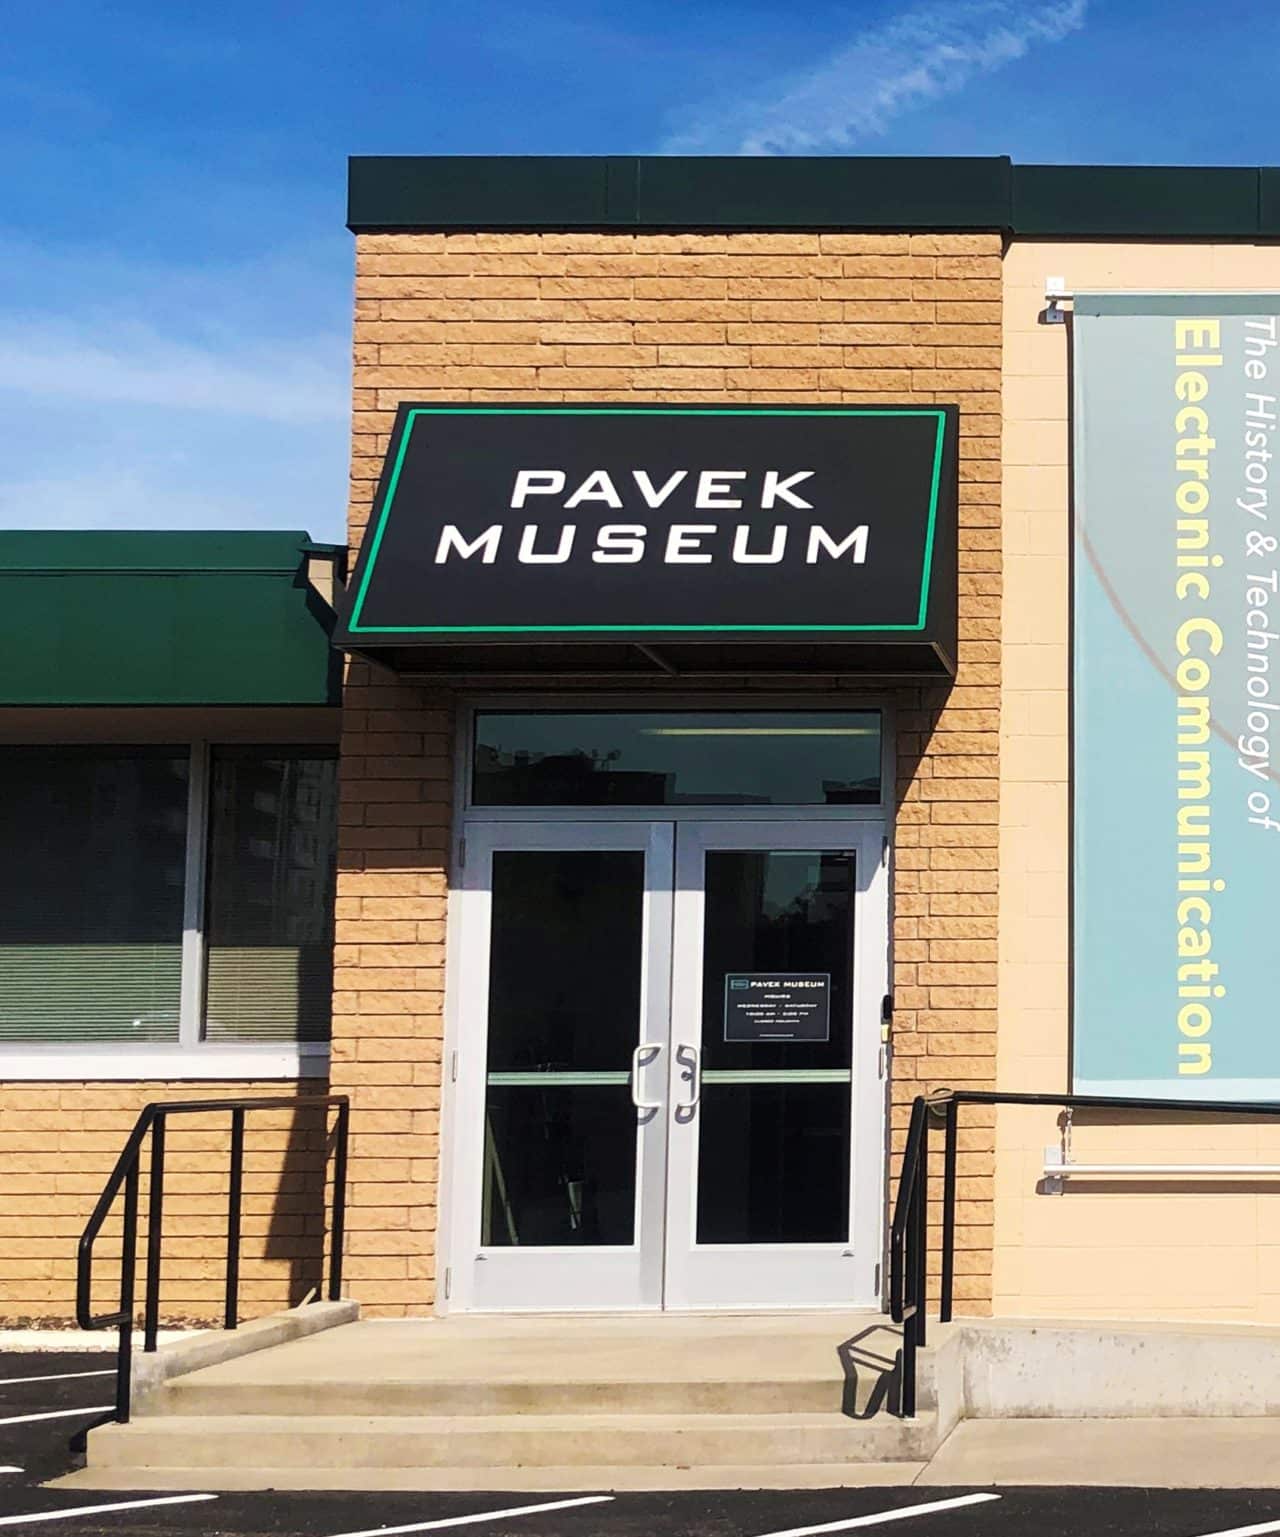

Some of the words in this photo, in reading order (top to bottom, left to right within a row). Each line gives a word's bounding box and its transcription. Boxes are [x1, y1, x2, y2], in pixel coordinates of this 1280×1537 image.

[1244, 316, 1278, 380] The
[1175, 319, 1222, 598] Electronic
[1236, 392, 1276, 521] History
[510, 470, 815, 509] PAVEK
[434, 524, 869, 564] MUSEUM
[1245, 530, 1278, 557] &
[1238, 570, 1280, 780] Technology
[1176, 617, 1225, 1074] Communication
[750, 980, 781, 988] PAVEK
[783, 980, 825, 988] MUSEUM
